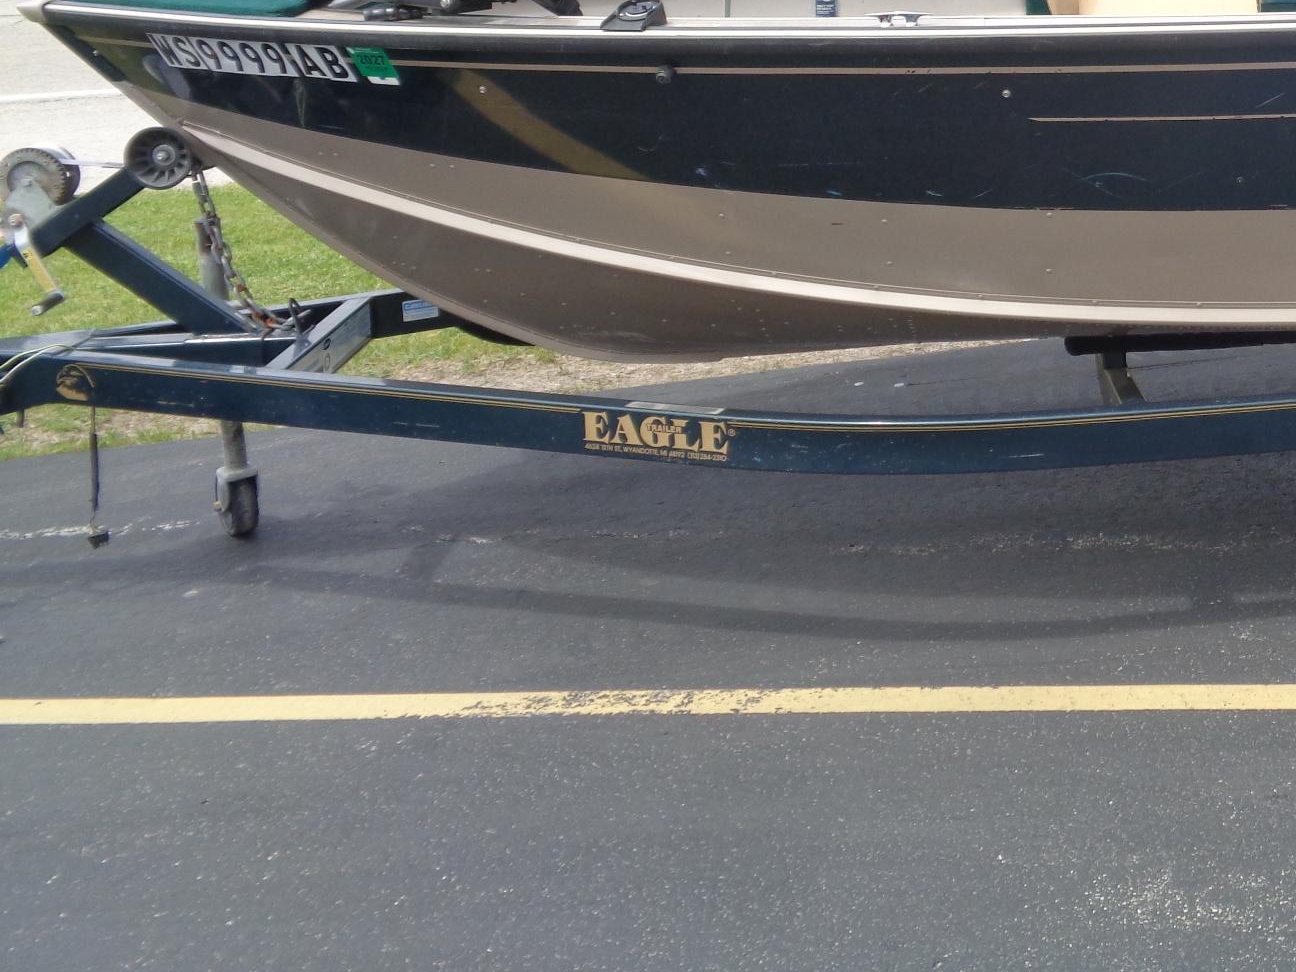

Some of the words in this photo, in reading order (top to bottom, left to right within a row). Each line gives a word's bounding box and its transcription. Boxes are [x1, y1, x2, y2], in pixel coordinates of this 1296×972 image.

[200, 38, 287, 75] 9999
[294, 44, 349, 79] AB
[357, 54, 385, 66] 2027
[582, 411, 730, 455] EAGLE
